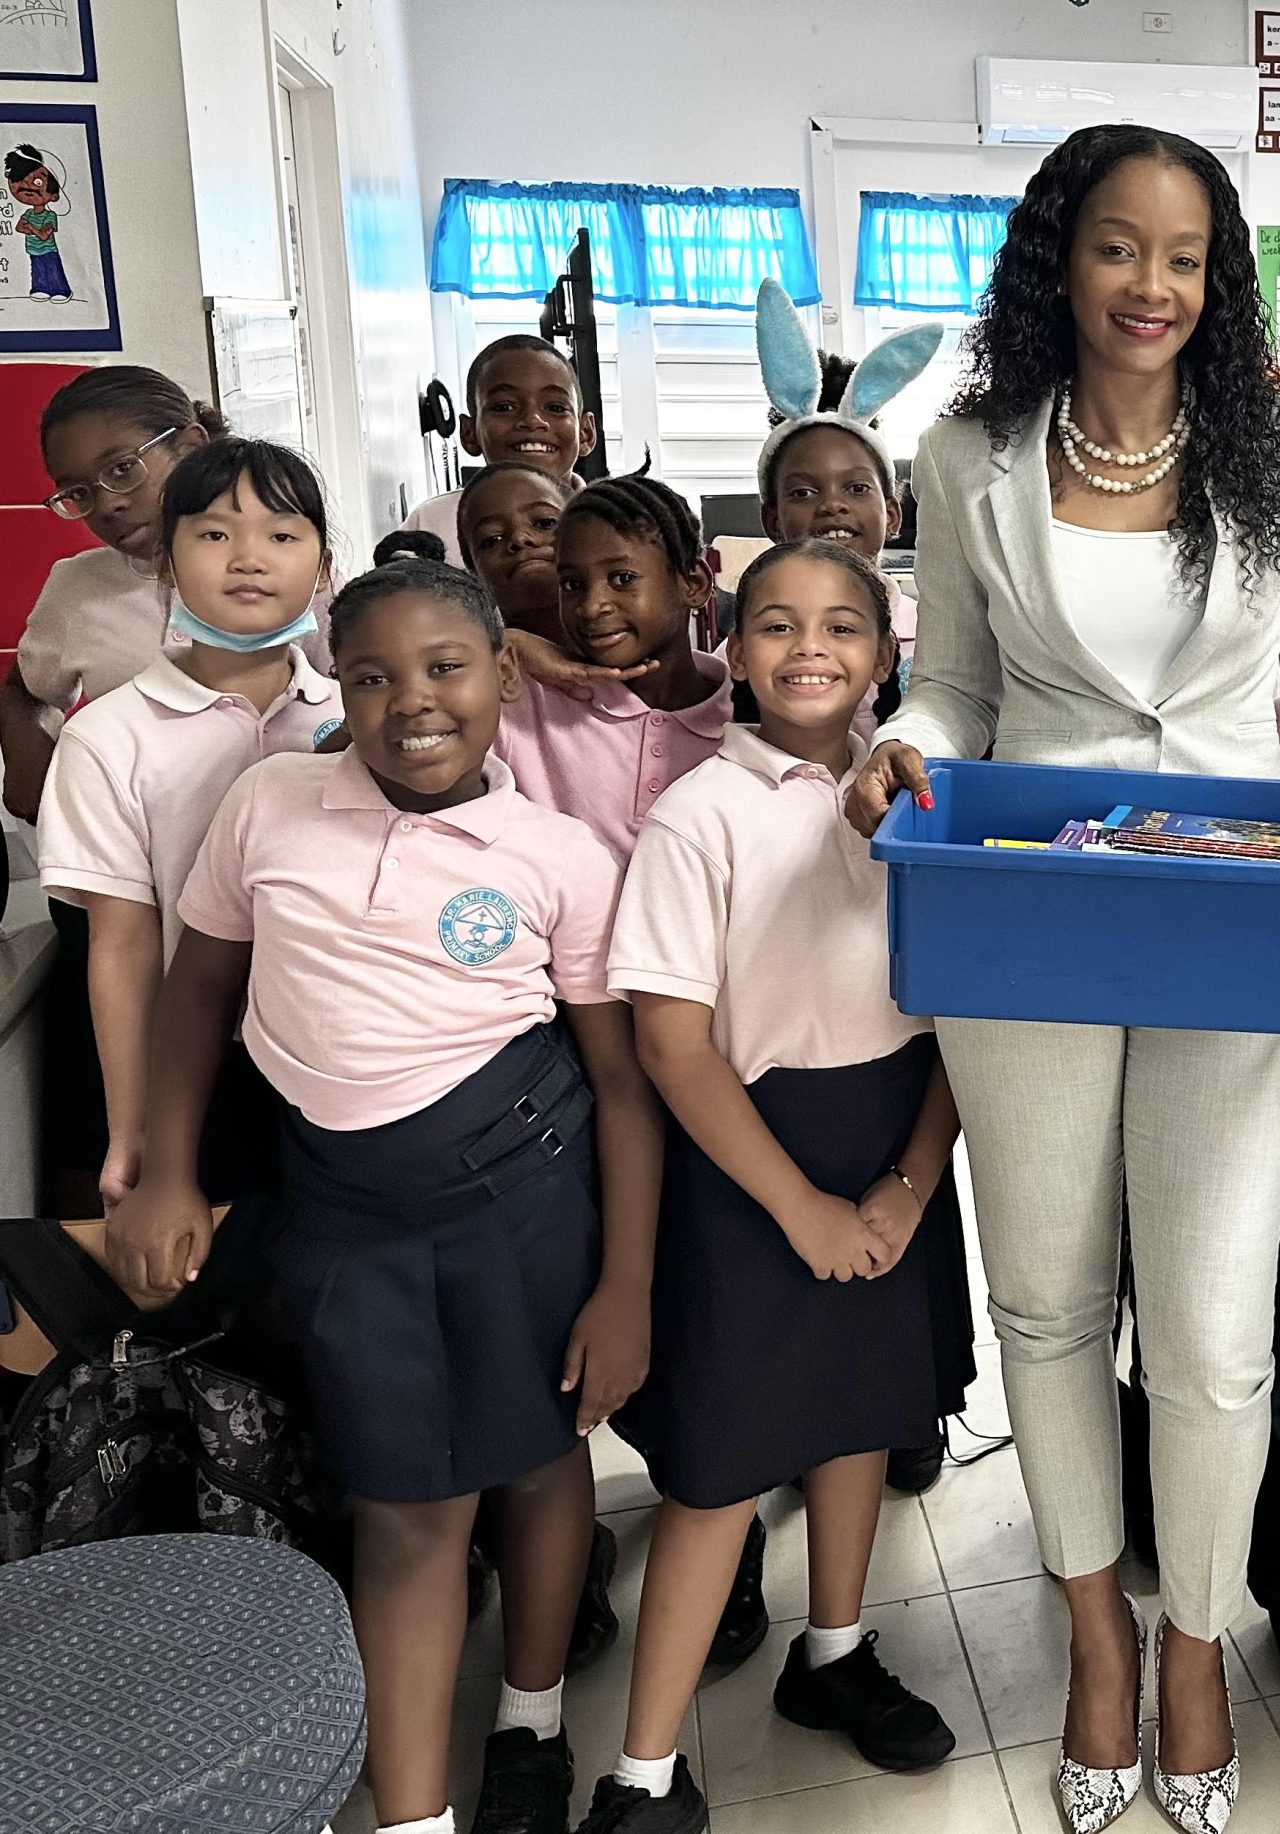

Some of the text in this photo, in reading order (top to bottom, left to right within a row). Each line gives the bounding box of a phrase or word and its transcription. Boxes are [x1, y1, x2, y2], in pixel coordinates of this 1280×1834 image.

[1260, 229, 1271, 243] De
[455, 892, 485, 909] MARIE
[488, 893, 515, 934] LAURENCE
[442, 930, 506, 962] PRIMARY SCHOOL
